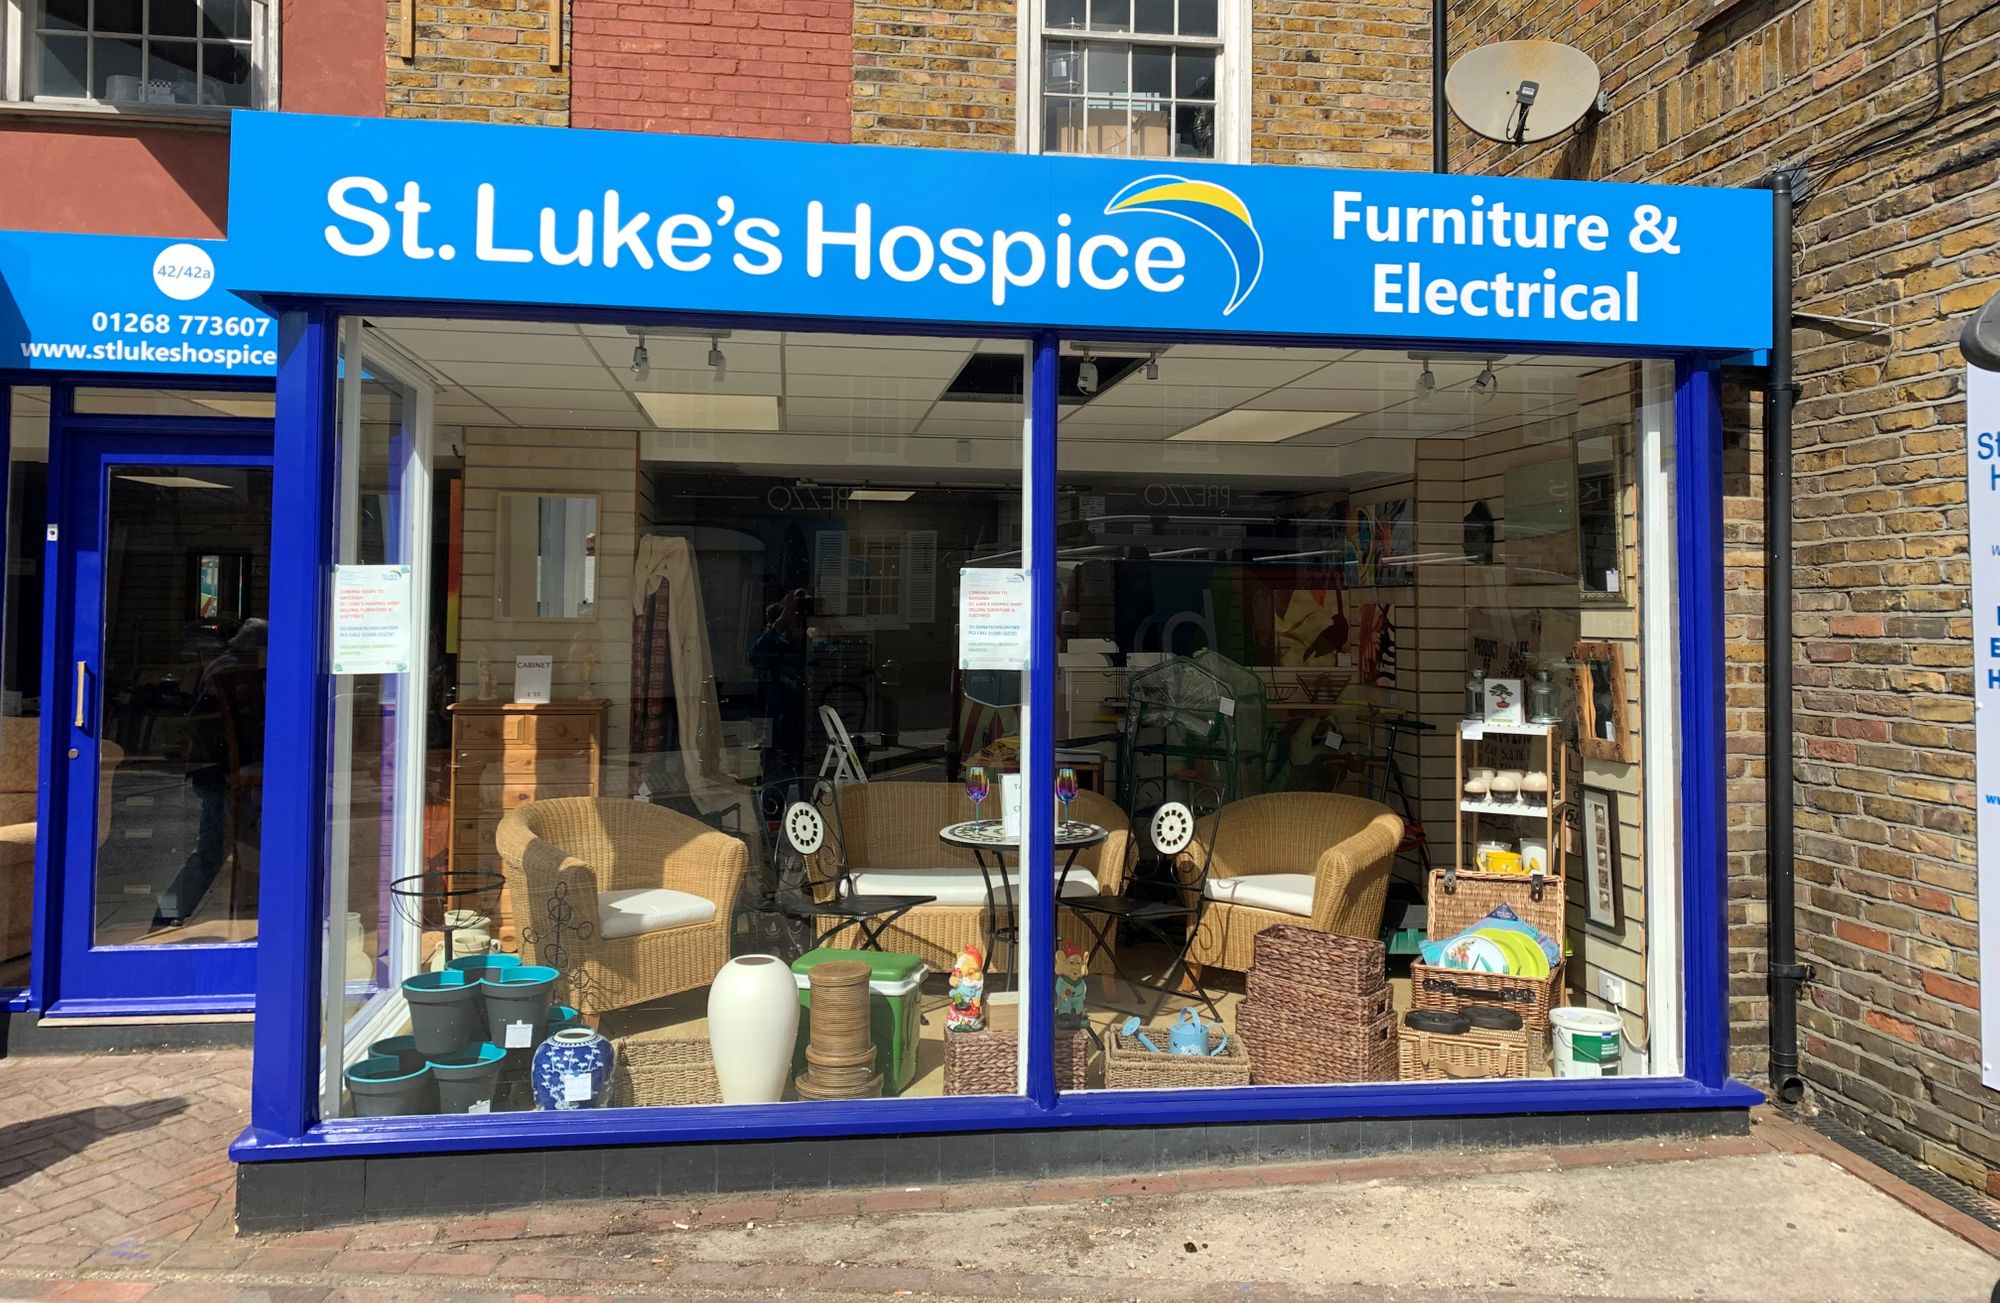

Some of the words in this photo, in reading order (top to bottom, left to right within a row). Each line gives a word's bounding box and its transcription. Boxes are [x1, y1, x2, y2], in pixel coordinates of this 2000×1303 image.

[1333, 190, 1610, 253] Furniture
[1627, 204, 1681, 255] &
[325, 176, 456, 261] St.
[476, 183, 783, 275] Luke's
[806, 200, 1186, 307] Hospice
[157, 264, 211, 280] 42/42a
[1373, 263, 1639, 323] Electrical
[92, 312, 170, 334] 01268
[179, 314, 270, 338] 773607
[21, 340, 277, 370] www.stlukeshospice
[516, 661, 551, 669] CABINET
